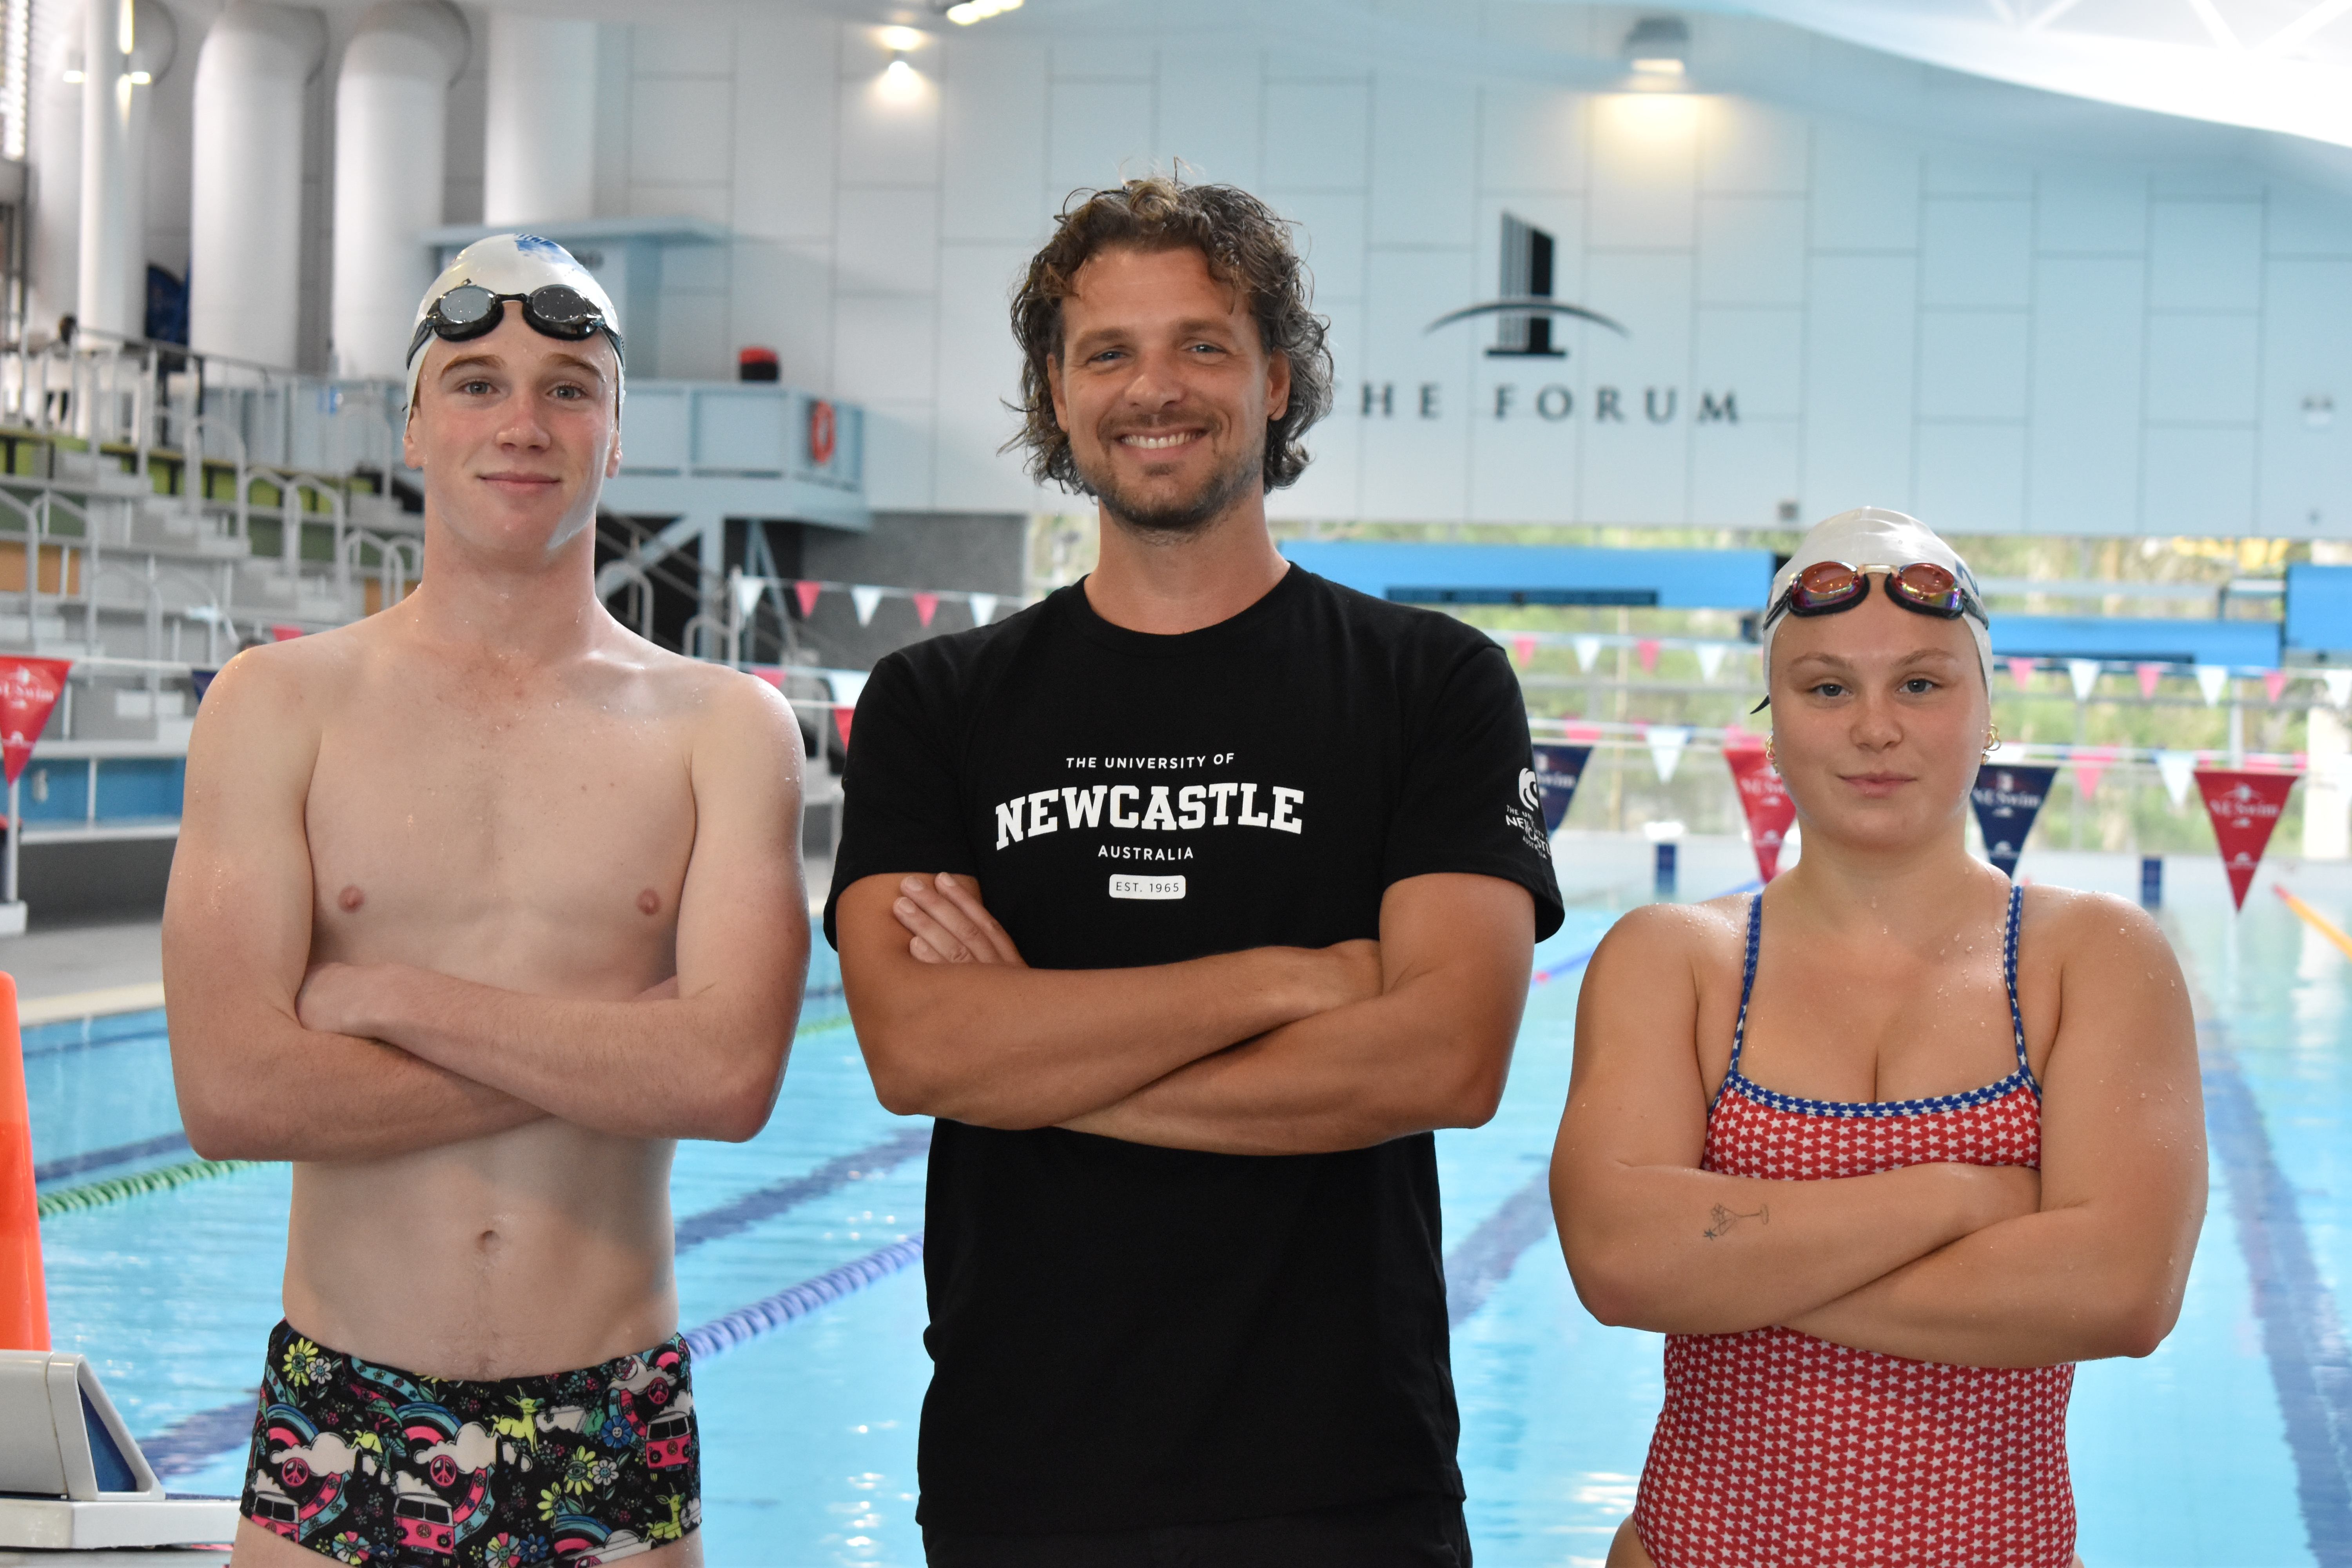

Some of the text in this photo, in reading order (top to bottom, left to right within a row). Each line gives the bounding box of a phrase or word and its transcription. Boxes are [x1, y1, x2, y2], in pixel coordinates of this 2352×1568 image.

[1359, 382, 1740, 423] HE FORUM
[1066, 753, 1235, 769] THE UNIVERSITY OF
[995, 782, 1305, 851] NEWCASTLE
[1506, 804, 1544, 838] THE UNIEITY
[1098, 845, 1194, 861] AUSTRALIA
[1505, 815, 1552, 857] NEWCASTL
[1116, 882, 1180, 893] EST. 1965
